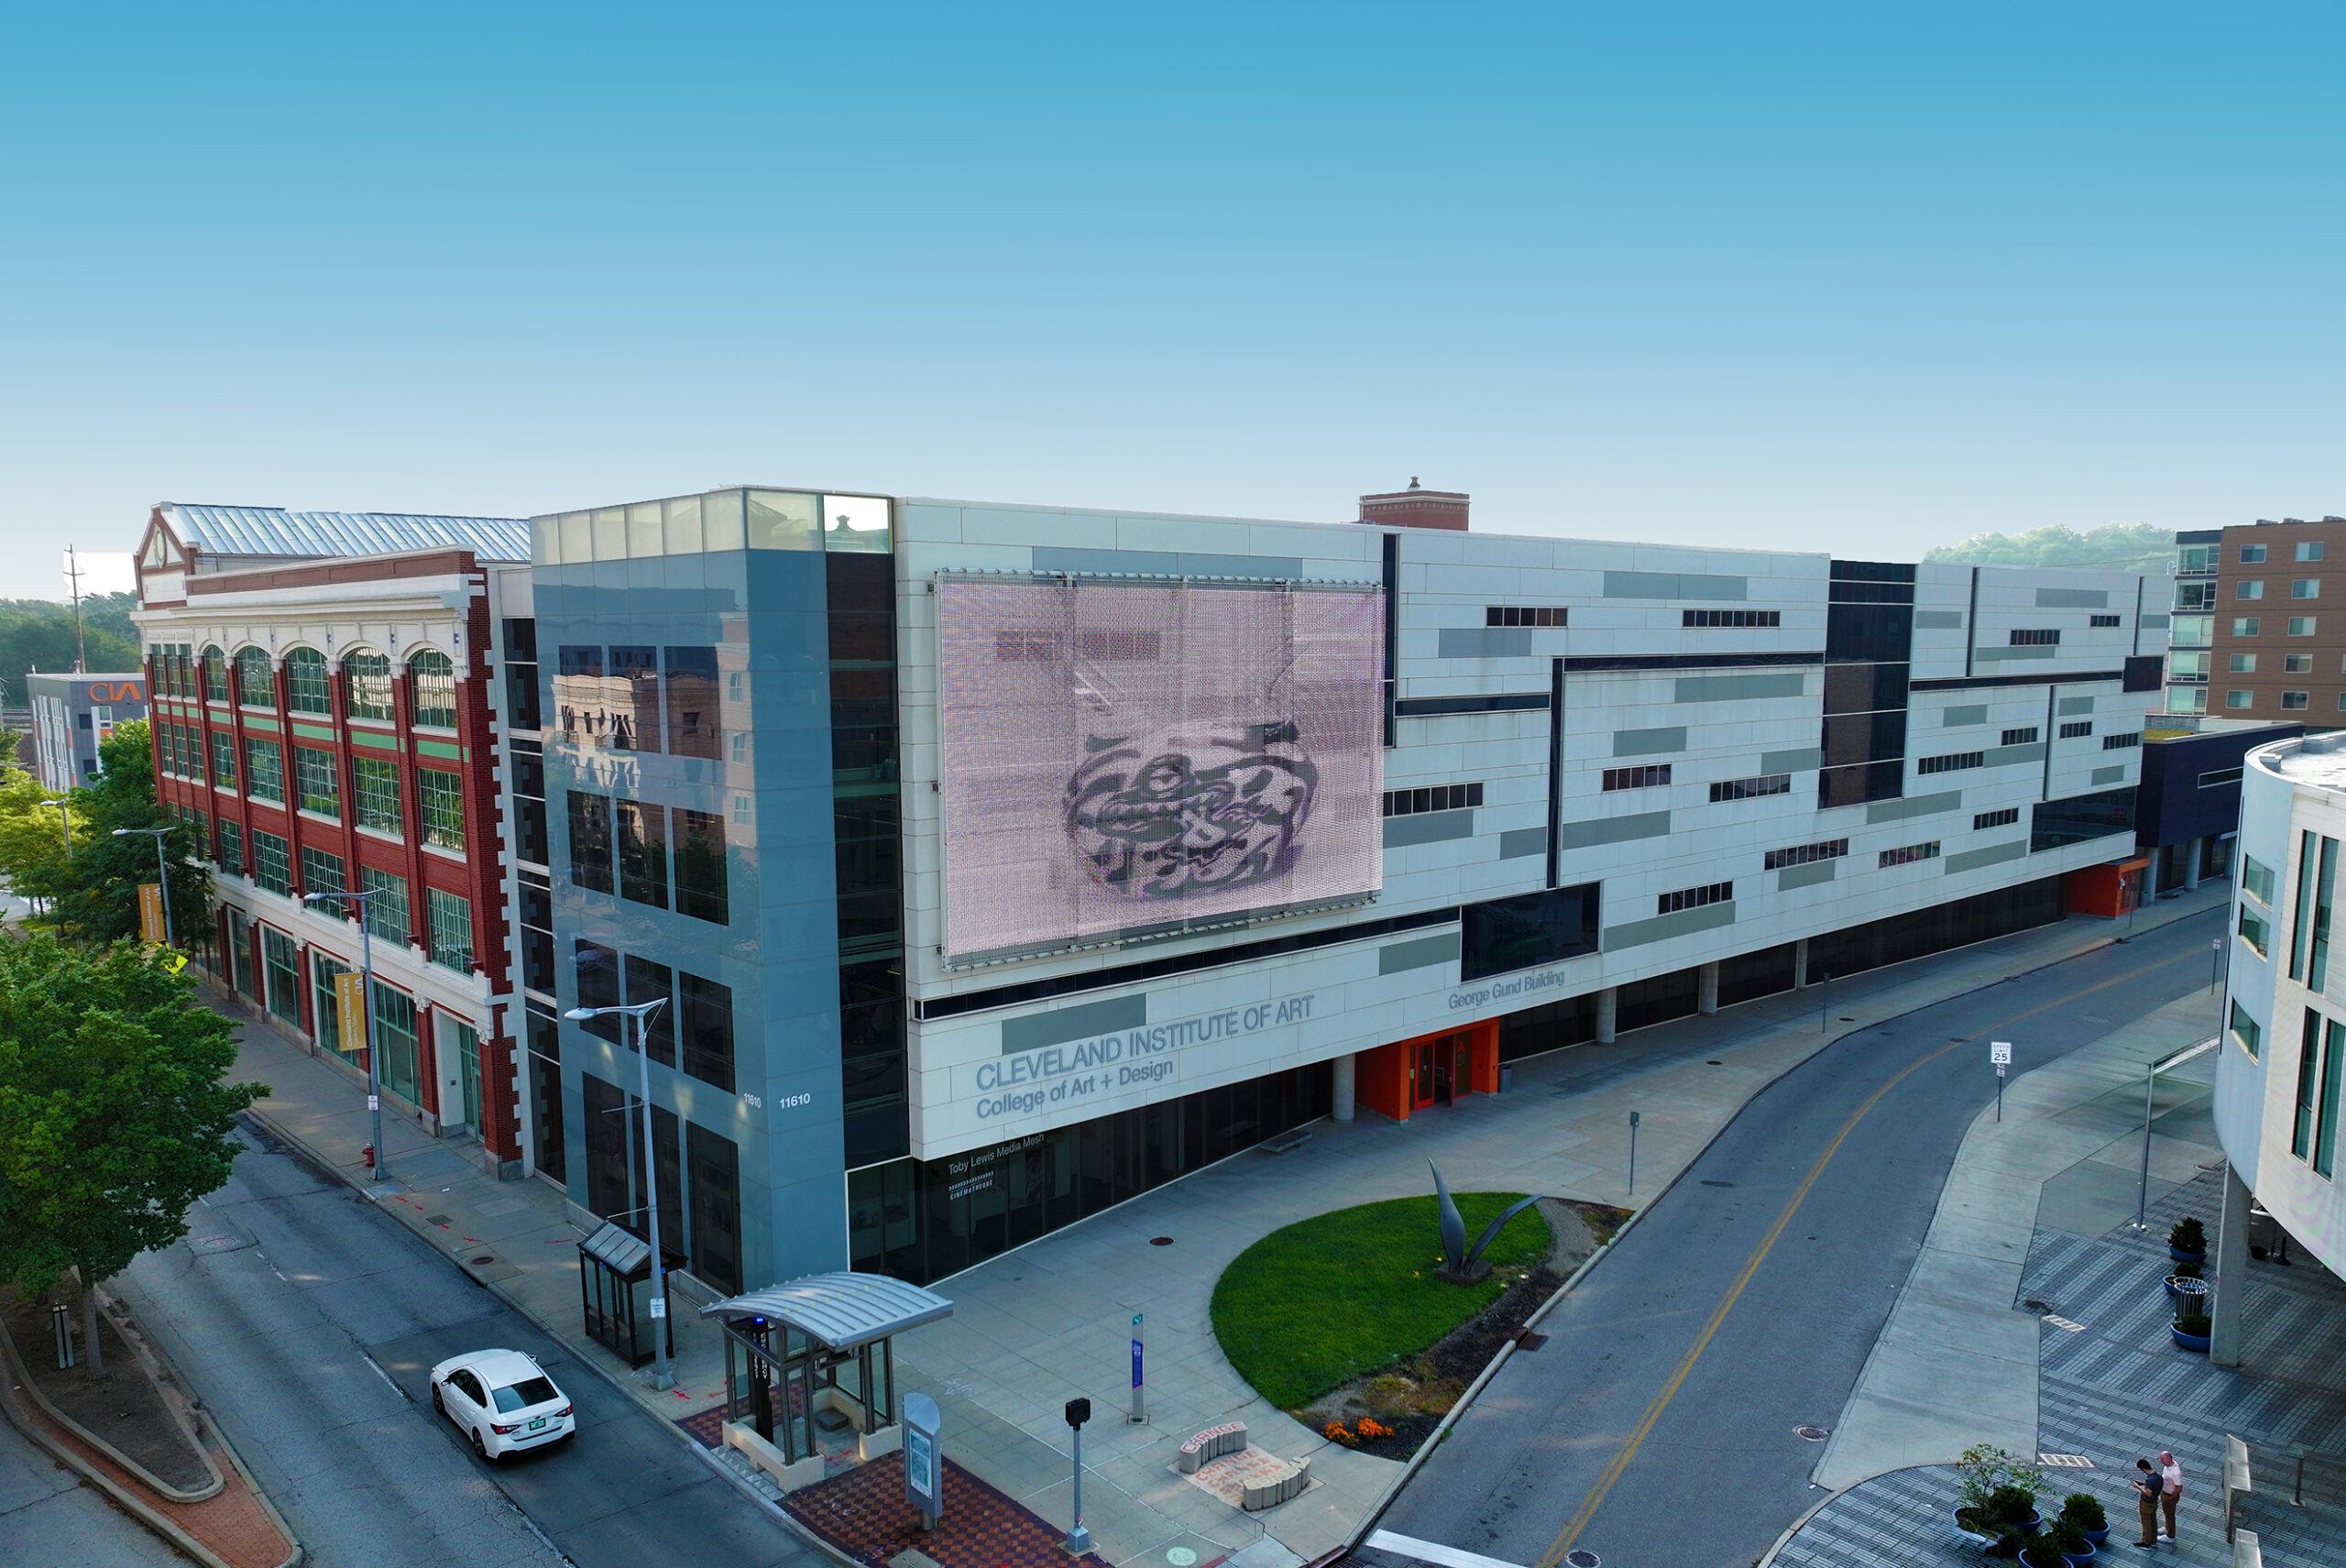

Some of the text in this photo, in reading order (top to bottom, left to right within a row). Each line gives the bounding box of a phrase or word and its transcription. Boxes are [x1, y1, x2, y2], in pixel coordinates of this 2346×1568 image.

[89, 683, 141, 702] CIA
[1448, 970, 1565, 1010] George Gund Building
[976, 994, 1315, 1091] CLEVELAND INSTITUTE OF ART
[1994, 1052, 2008, 1061] 25
[743, 1092, 762, 1108] 11610
[779, 1092, 811, 1109] 11610
[976, 1060, 1173, 1120] College of Art + Design
[948, 1133, 1045, 1175] Toby Lewis Media Mesh
[949, 1179, 994, 1201] CINEMATHEQUE
[1182, 1422, 1244, 1453] CHANGE
